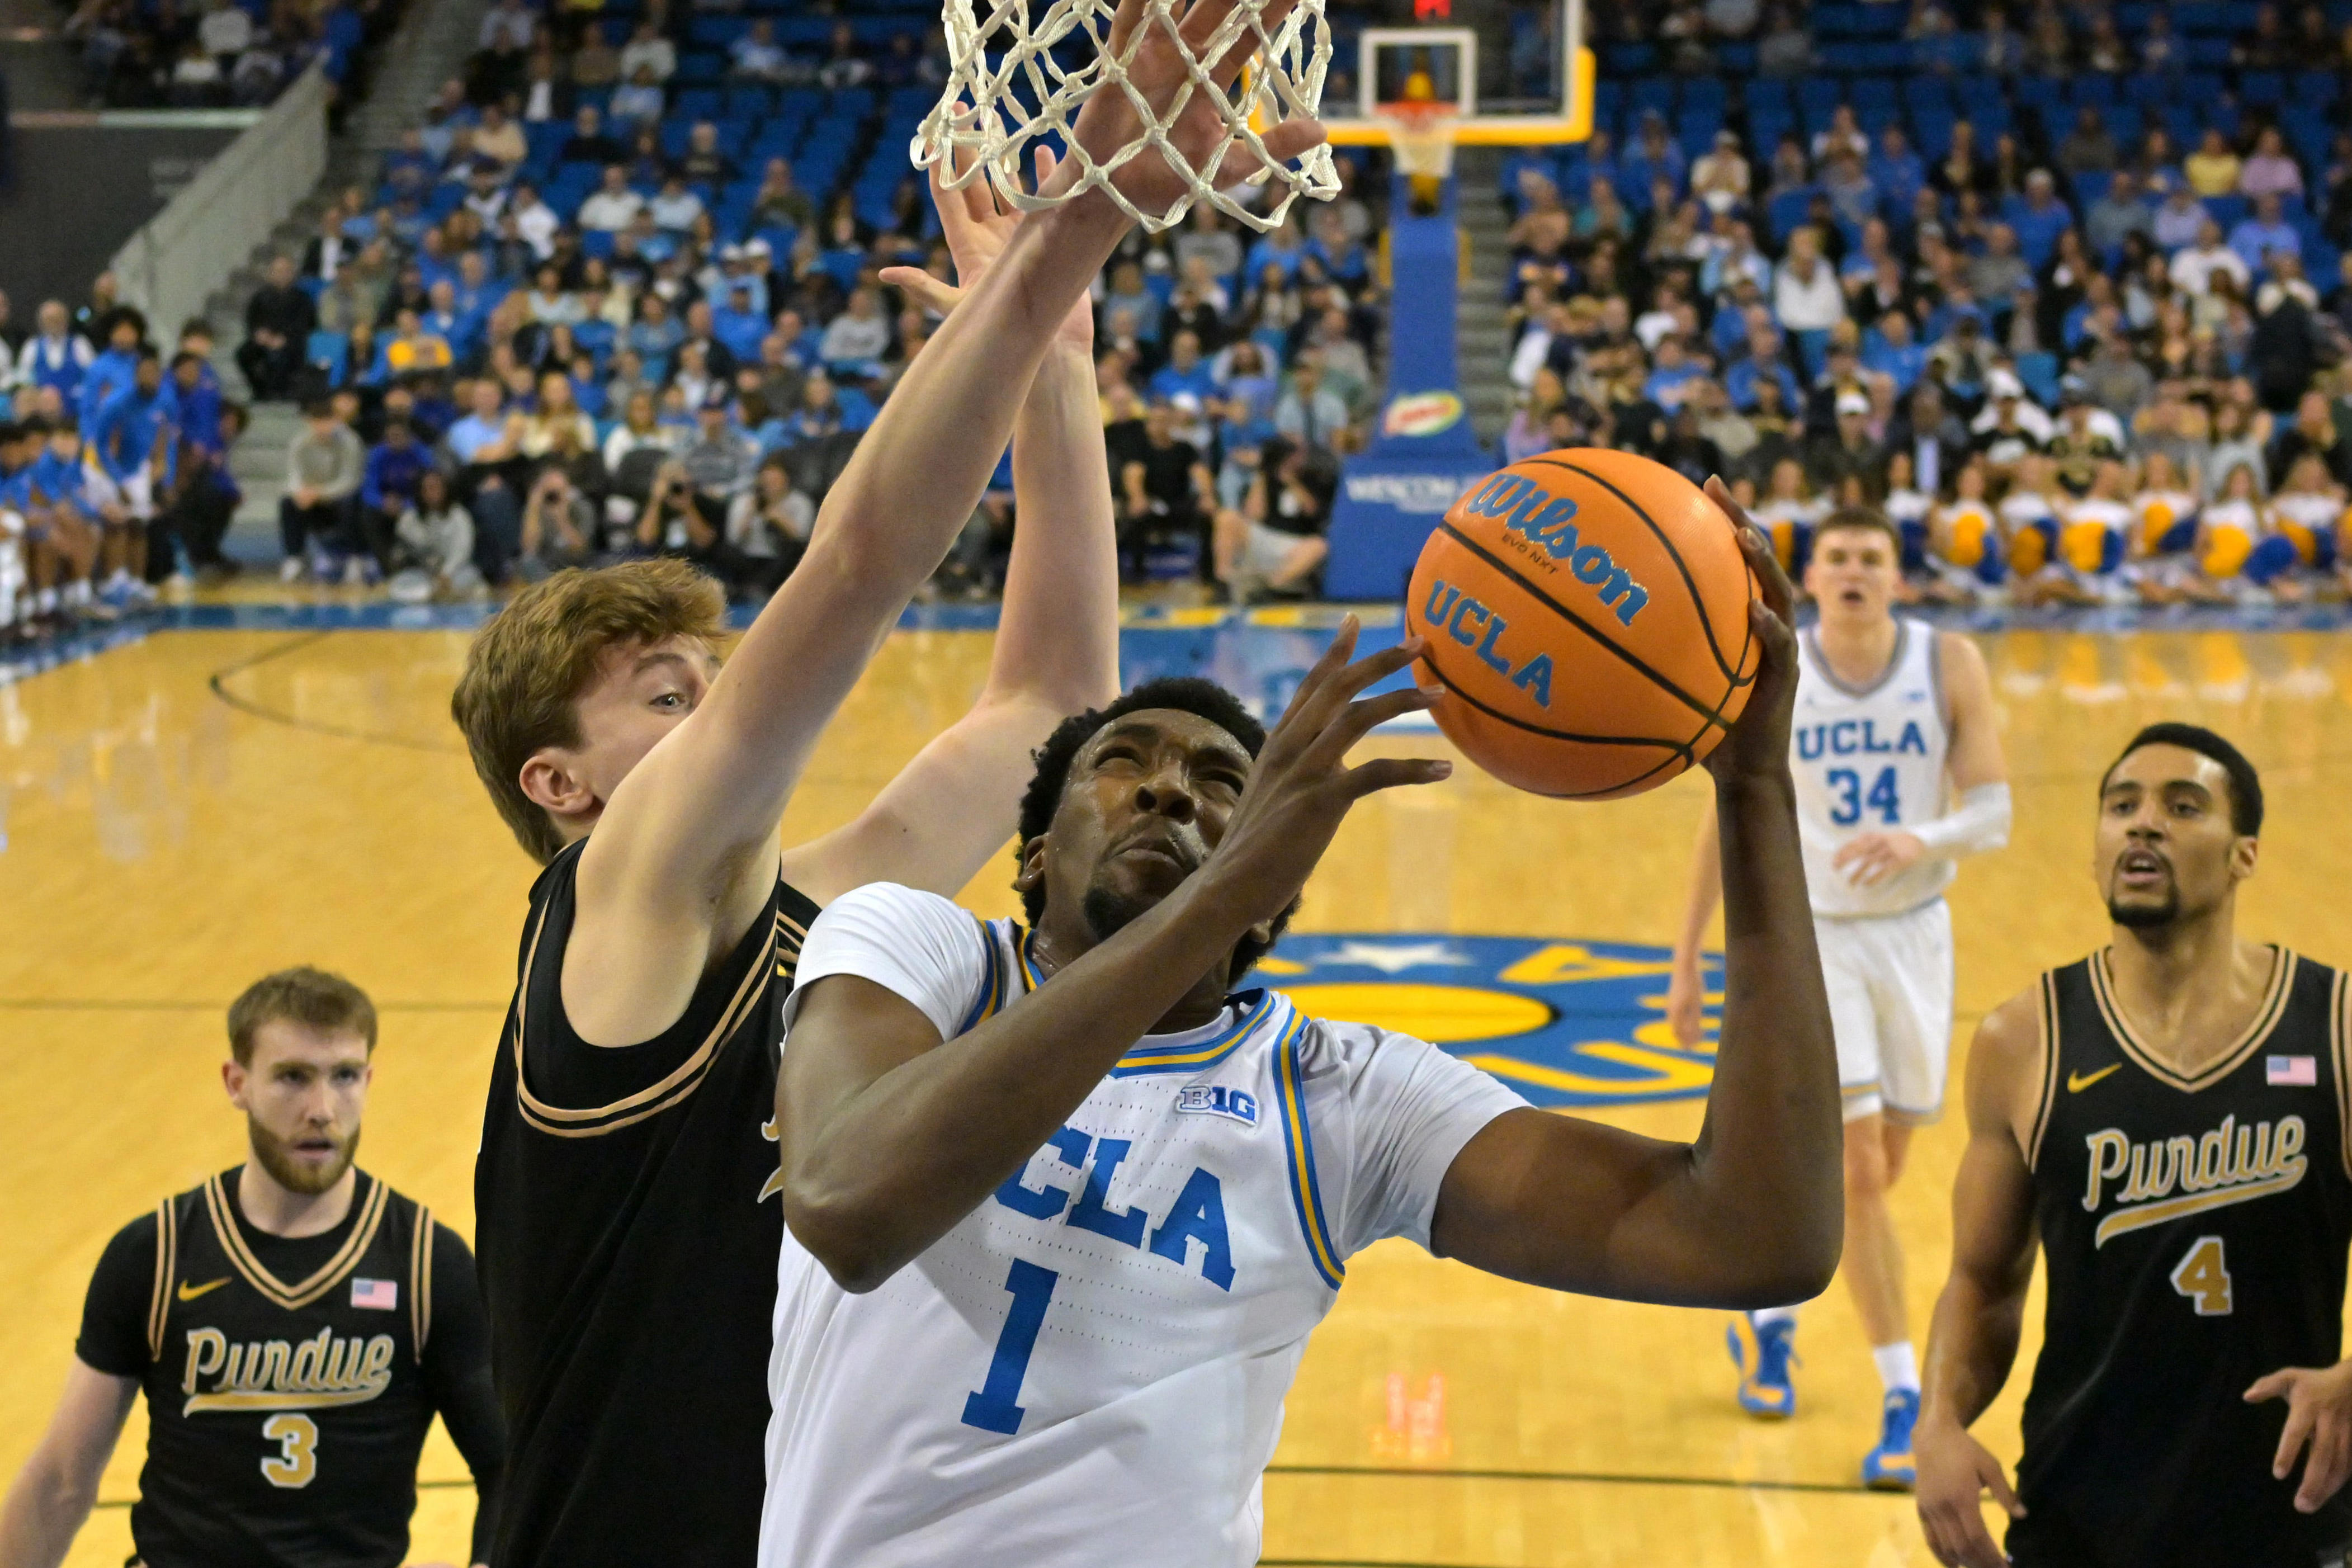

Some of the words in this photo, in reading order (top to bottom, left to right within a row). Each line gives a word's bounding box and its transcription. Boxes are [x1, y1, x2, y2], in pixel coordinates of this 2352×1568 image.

[1467, 474, 1649, 627] Wilson
[1501, 533, 1528, 553] EVO
[1529, 550, 1558, 574] NXT
[1424, 579, 1553, 710] UCLA
[1796, 720, 1926, 761] UCLA
[1827, 765, 1900, 825] 34
[2082, 1113, 2308, 1219] Purdue
[994, 1125, 1236, 1292] CLA
[2170, 1235, 2233, 1316] 4
[182, 1325, 394, 1401] Purdue
[961, 1257, 1059, 1435] 1
[261, 1414, 319, 1488] 3
